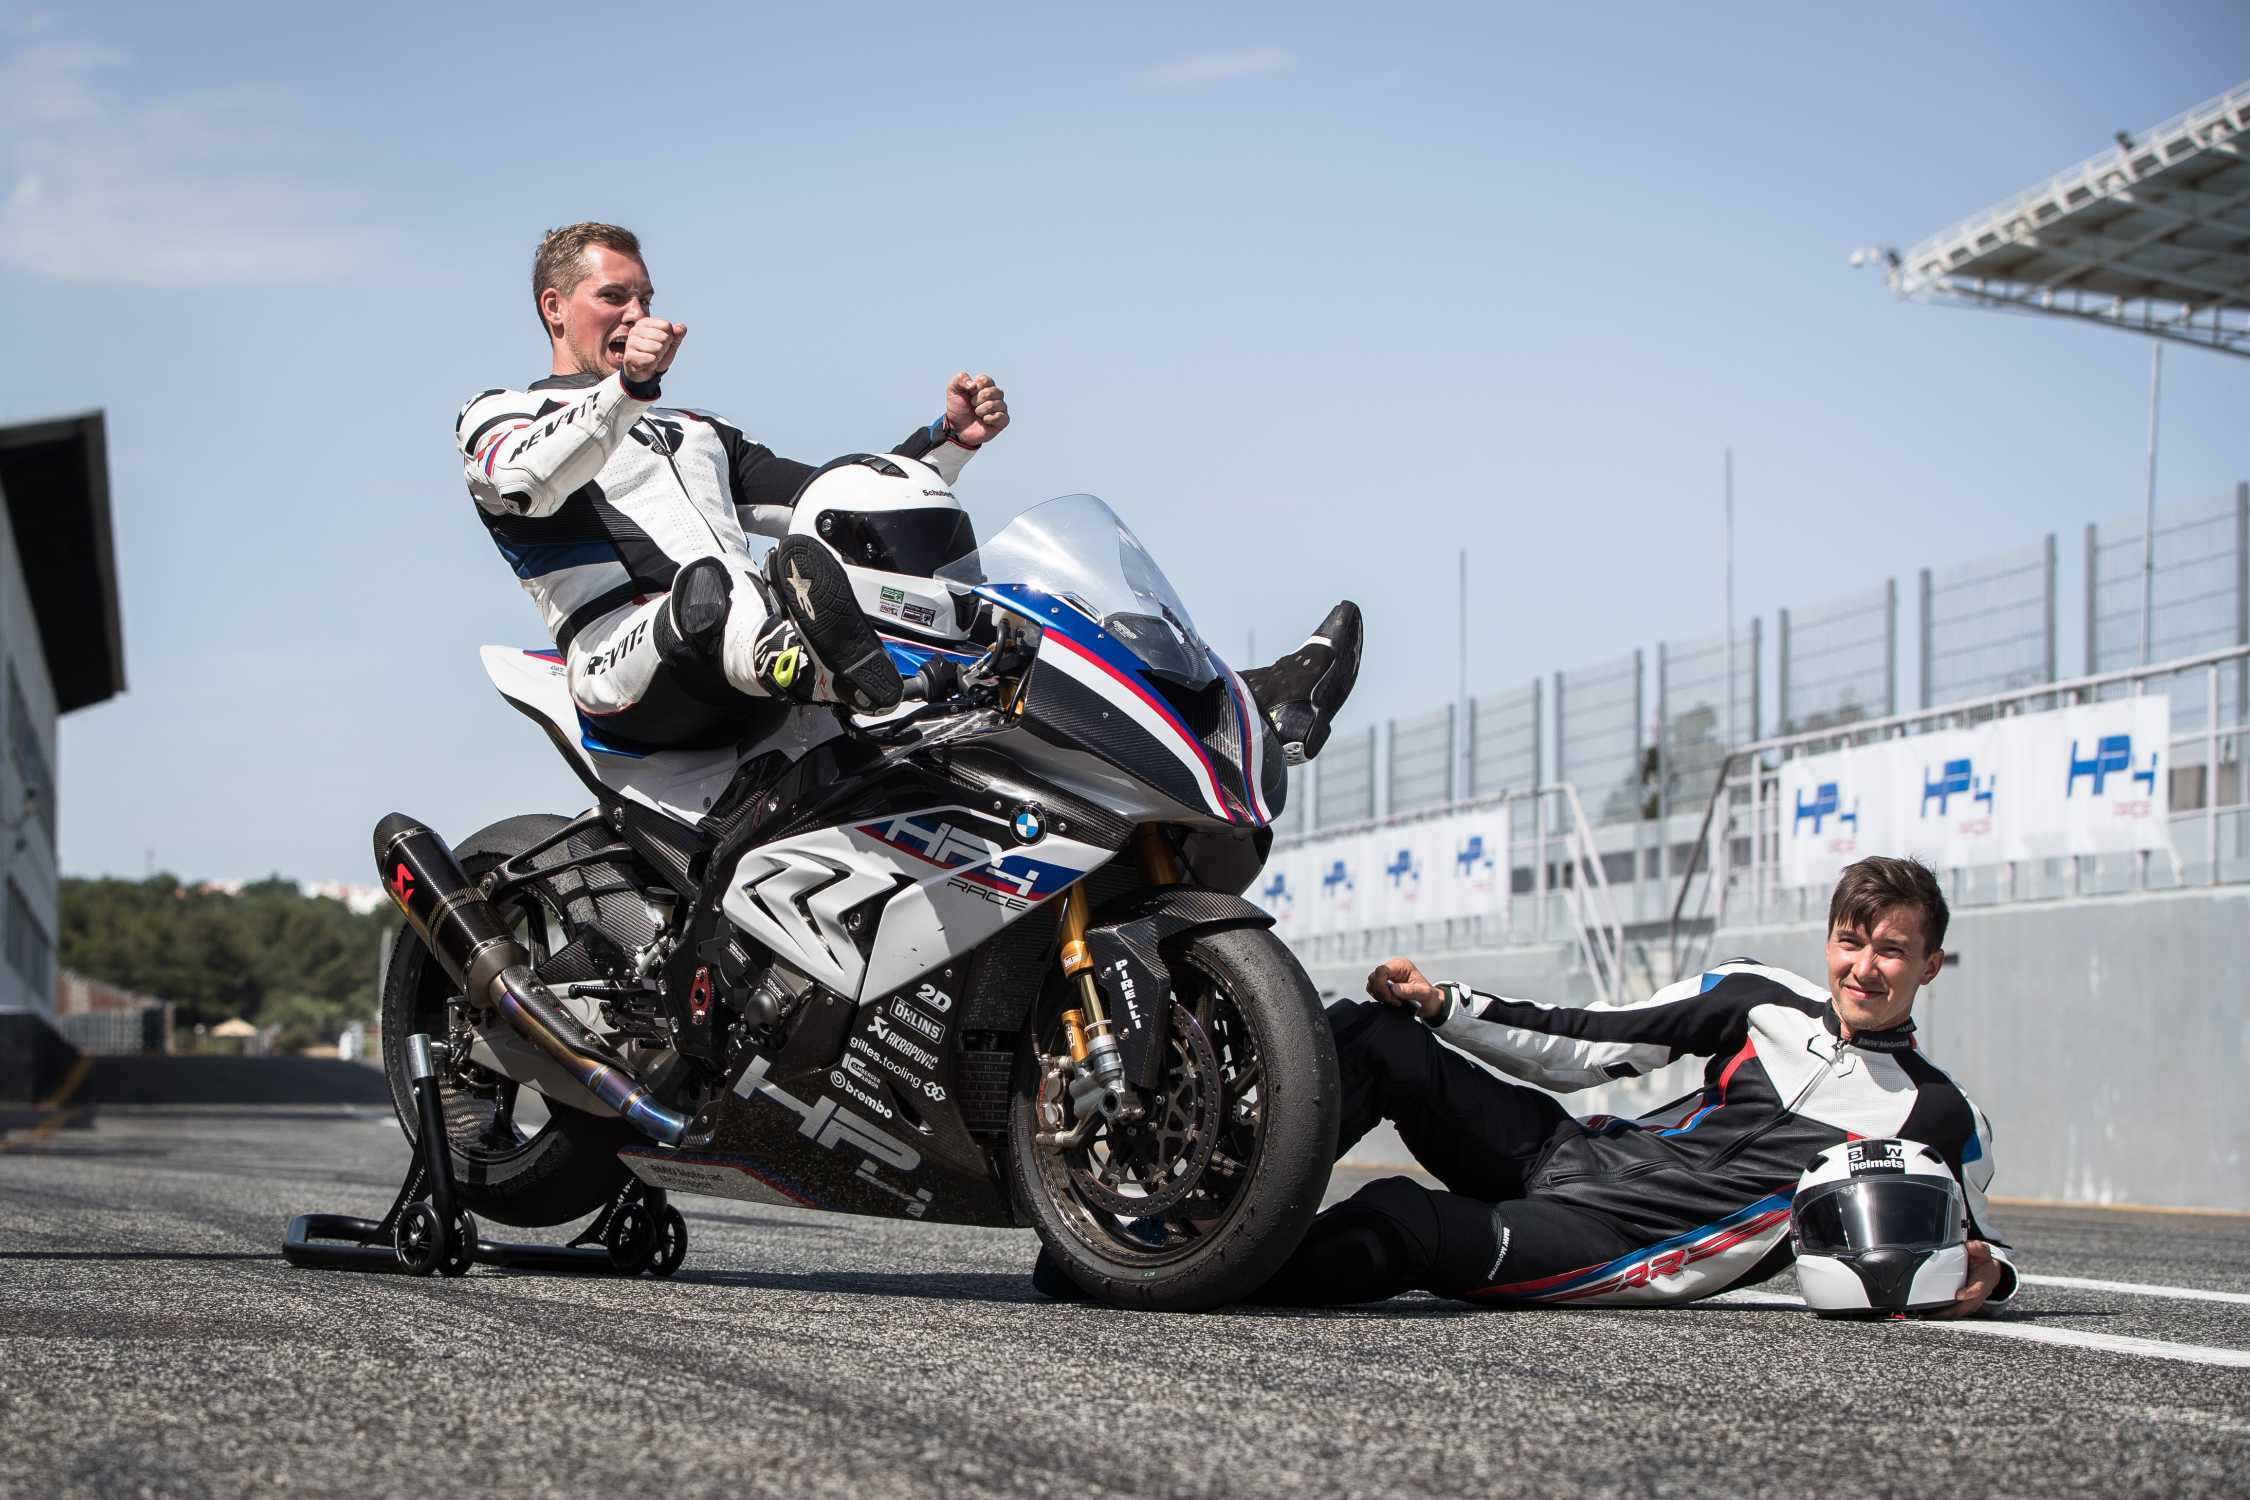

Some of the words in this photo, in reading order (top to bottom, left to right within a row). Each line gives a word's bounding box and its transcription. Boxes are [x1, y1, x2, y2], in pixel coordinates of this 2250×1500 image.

[2067, 734, 2156, 797] HP4
[1922, 758, 1995, 818] HP4
[947, 877, 1028, 911] RACE
[916, 983, 952, 1013] 2D
[1115, 958, 1141, 1030] PIRELLI
[894, 999, 941, 1038] ÖHLINS
[849, 1036, 921, 1088] gilles.tooling
[845, 1080, 892, 1119] brembo
[1848, 1146, 1903, 1160] BW
[1849, 1158, 1904, 1171] helmets
